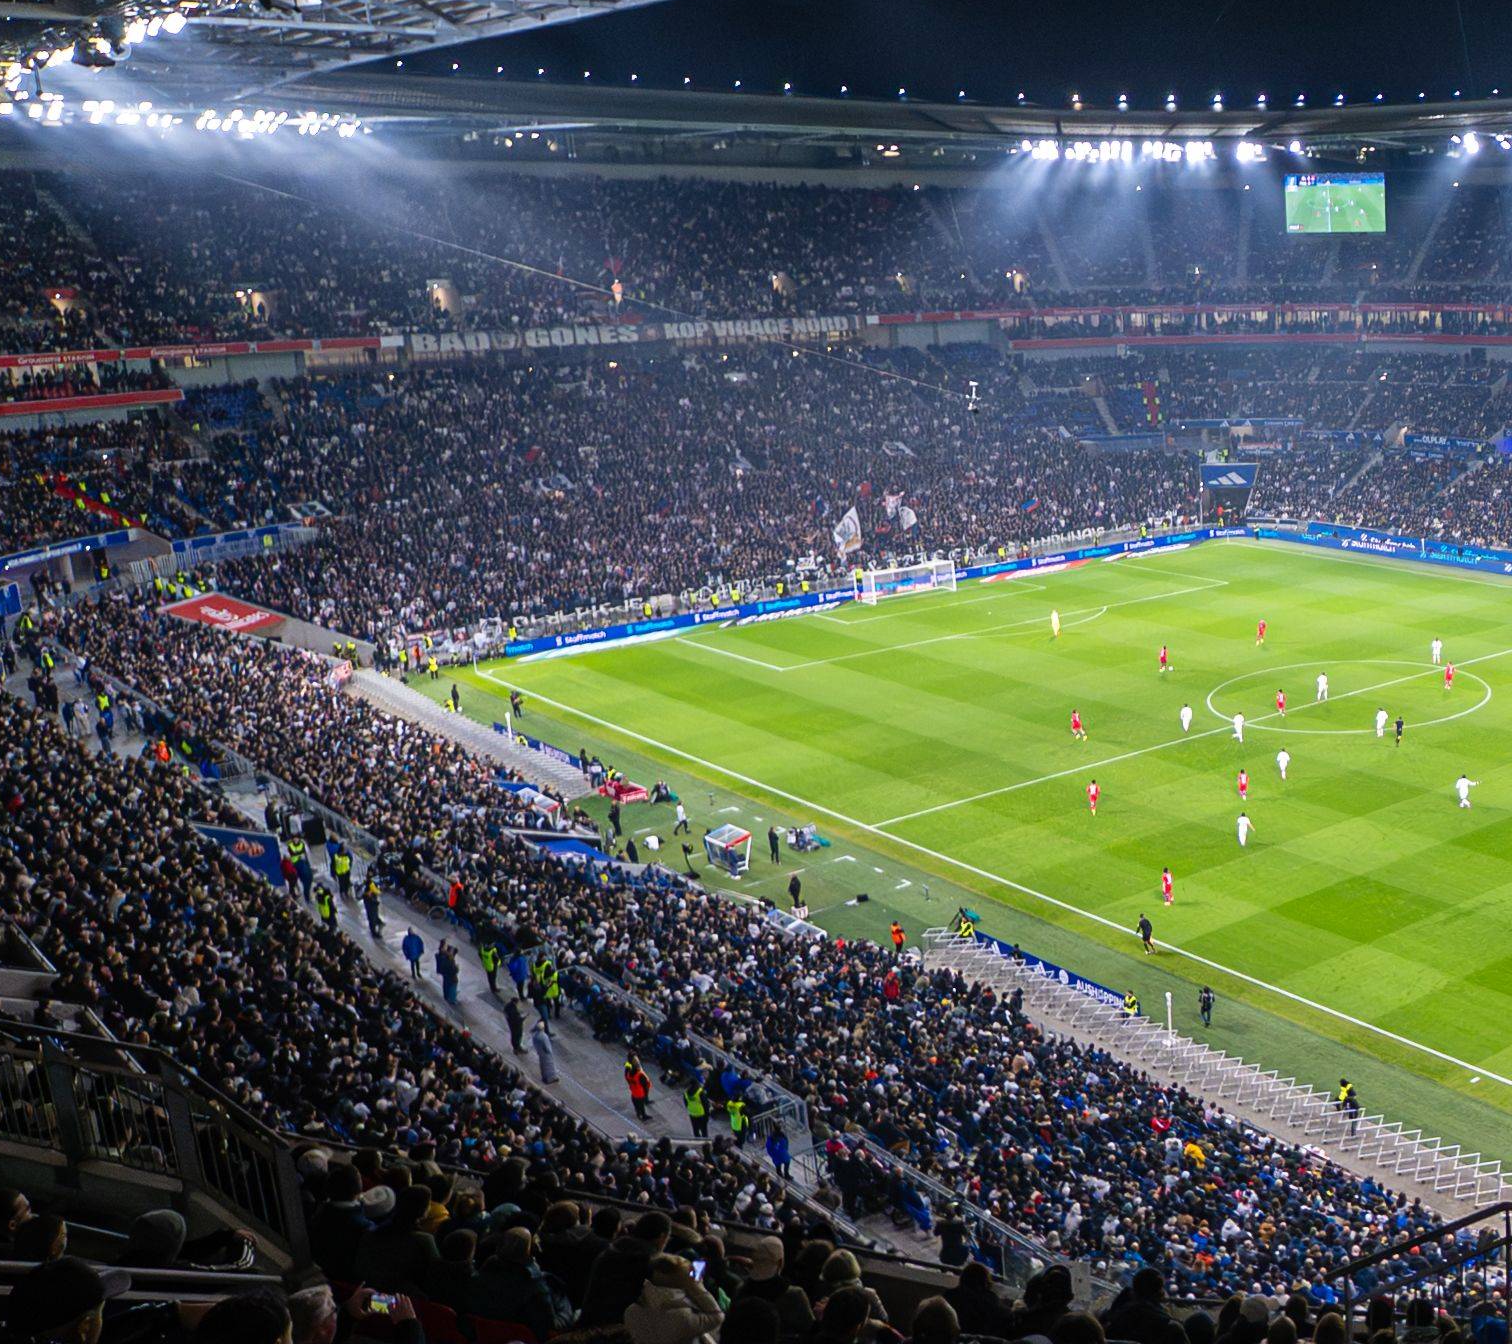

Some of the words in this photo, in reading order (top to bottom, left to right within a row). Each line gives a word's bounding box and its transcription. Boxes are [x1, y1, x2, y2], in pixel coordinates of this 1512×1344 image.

[411, 332, 490, 352] BAD
[524, 326, 639, 347] GONES
[664, 323, 709, 339] KOP
[711, 318, 791, 337] VIRAGE
[792, 316, 849, 333] NORD
